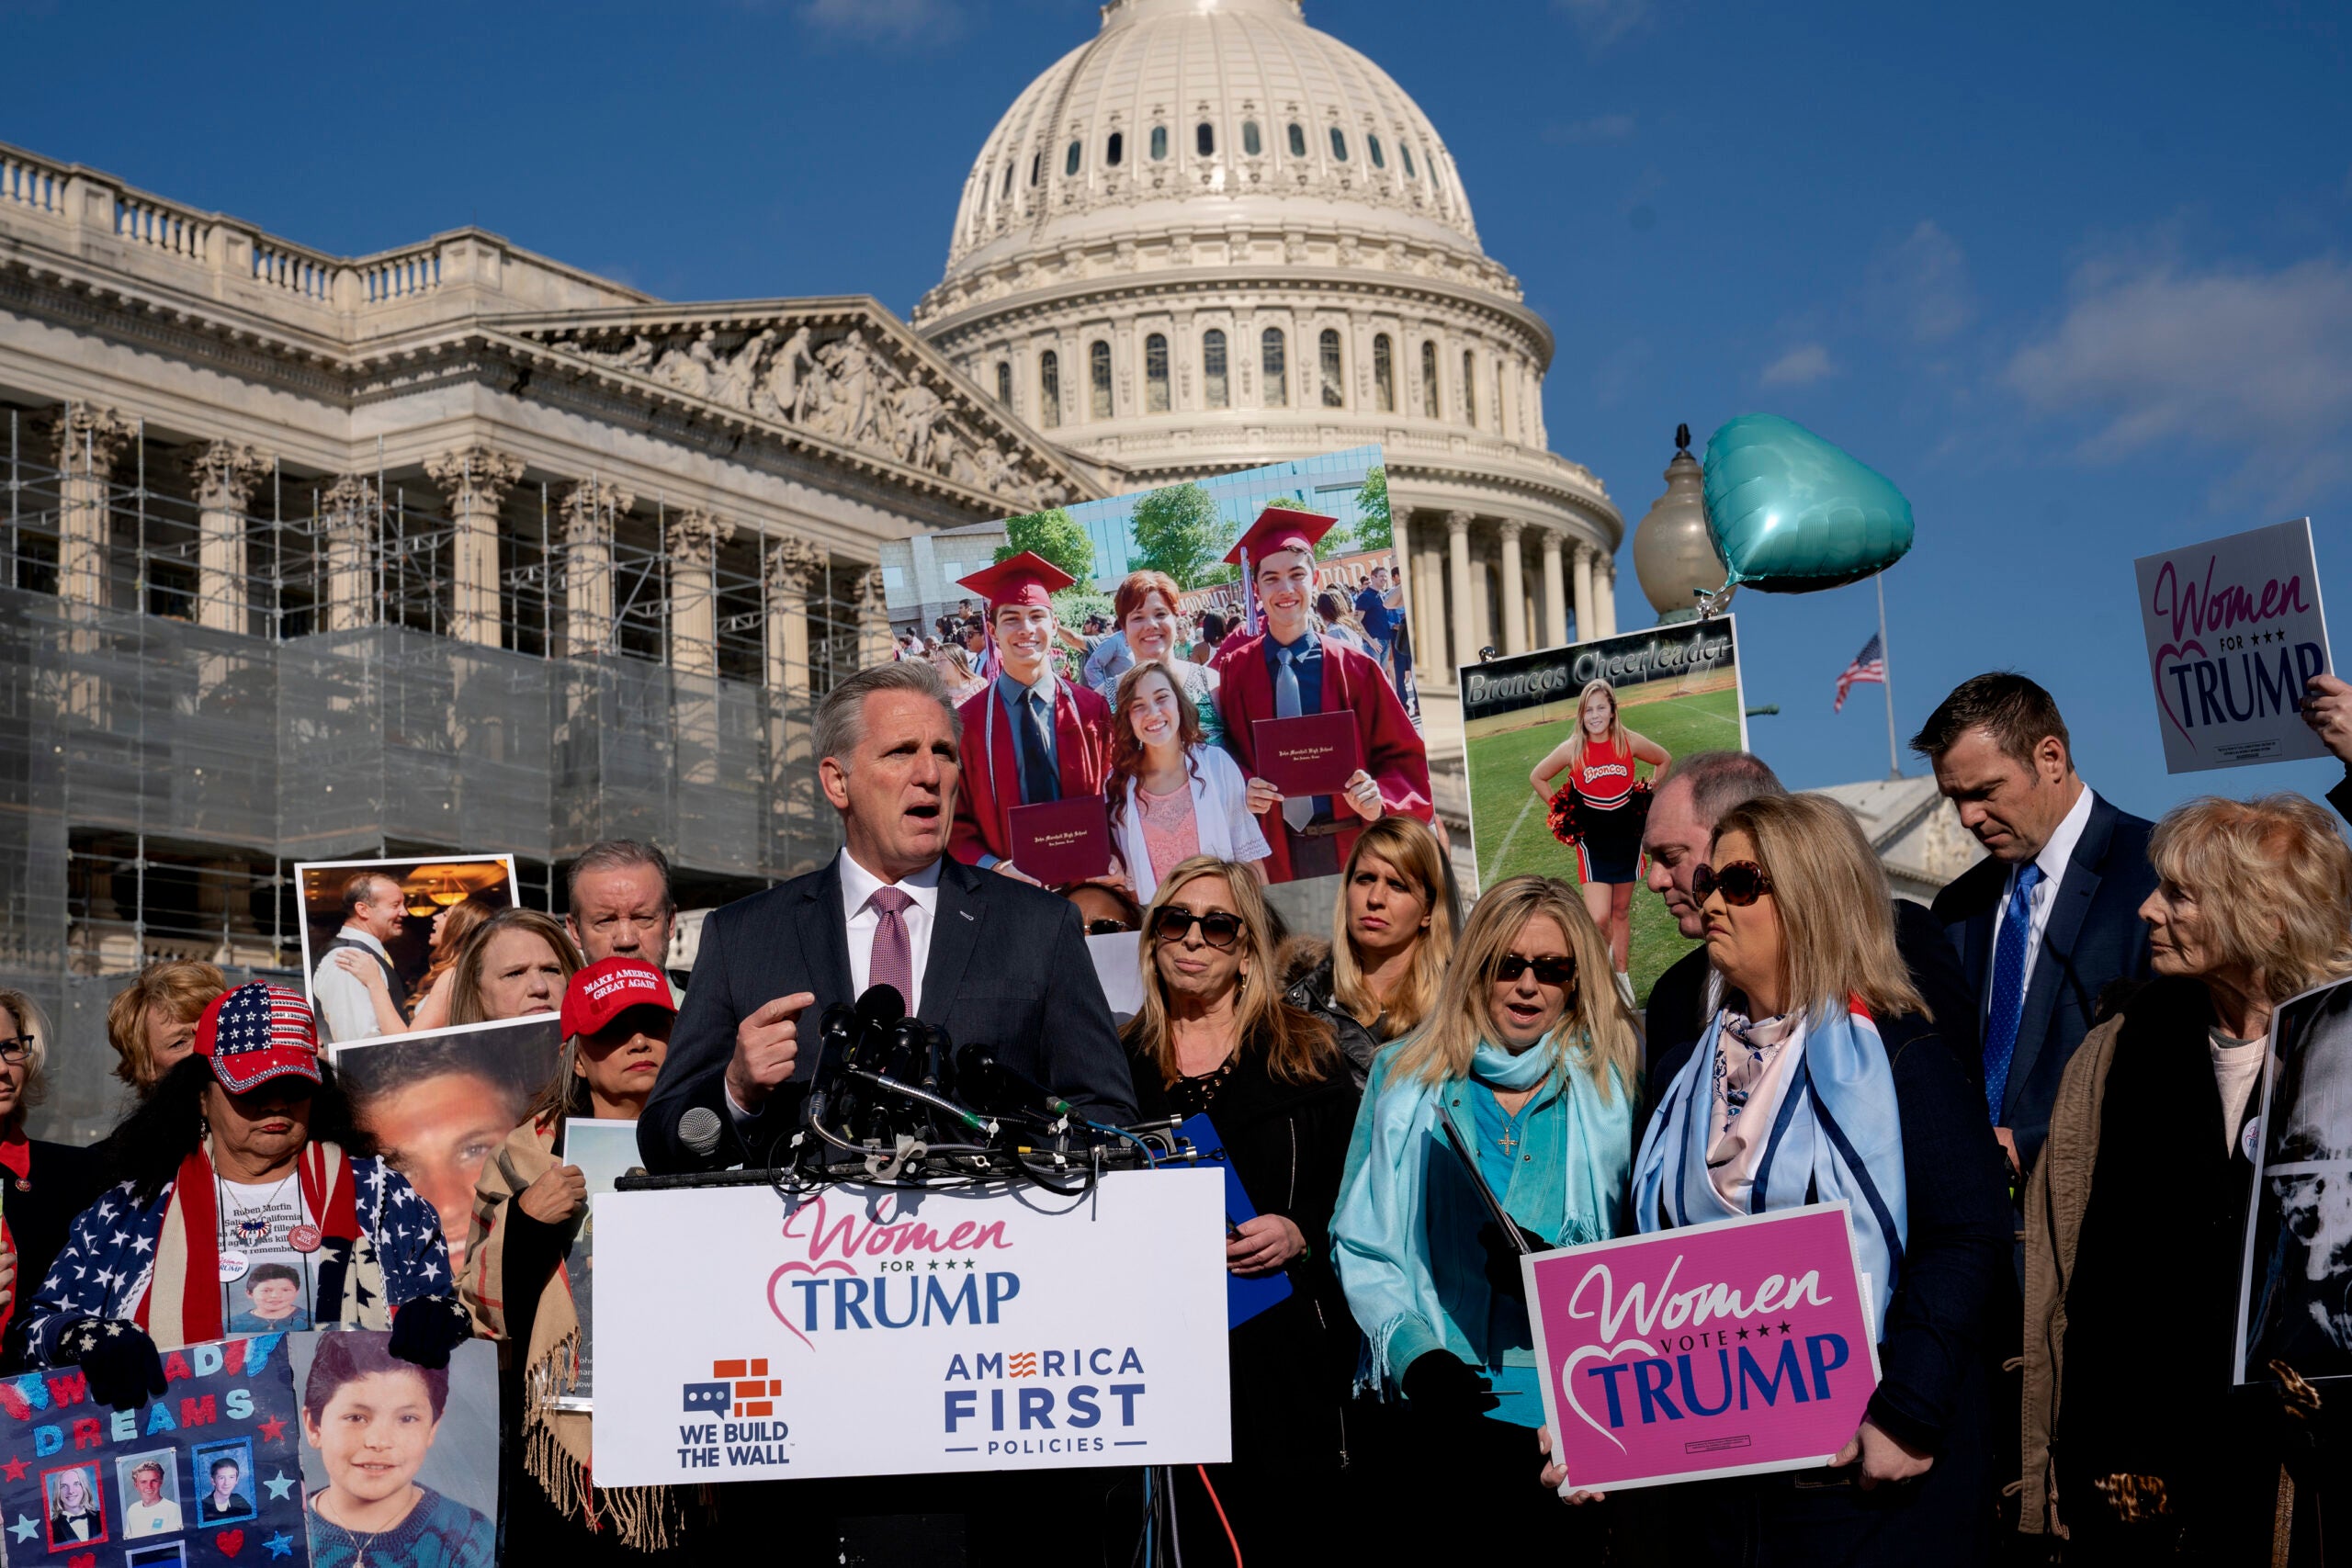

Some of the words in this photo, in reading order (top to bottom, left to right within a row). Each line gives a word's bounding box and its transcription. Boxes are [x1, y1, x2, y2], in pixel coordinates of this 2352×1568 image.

[2154, 555, 2310, 642] Women
[2220, 635, 2244, 652] FOR
[1469, 665, 1566, 704] Broncos
[1574, 633, 1728, 684] Cheerleader
[2168, 642, 2324, 728] TRUMP
[1583, 764, 1628, 784] Broncos
[583, 974, 614, 995] MAKE
[616, 969, 659, 982] AMERICA
[594, 980, 625, 999] GREAT
[628, 979, 656, 990] AGAIN
[232, 1206, 261, 1217] Ruben
[263, 1202, 292, 1213] Morfin
[783, 1195, 1013, 1261] Women
[880, 1260, 914, 1272] FOR
[792, 1272, 1021, 1332] TRUMP
[1568, 1255, 1832, 1343] Women
[1660, 1330, 1727, 1354] VOTE
[944, 1347, 1145, 1381] AMERICA
[1588, 1333, 1849, 1429] TRUMP
[33, 1388, 254, 1458] DREAMS
[944, 1383, 1146, 1433] FIRST
[680, 1424, 717, 1445] WE
[724, 1421, 788, 1443] BUILD
[988, 1437, 1104, 1455] POLICIES
[677, 1447, 719, 1468] THE
[727, 1444, 790, 1466] WALL
